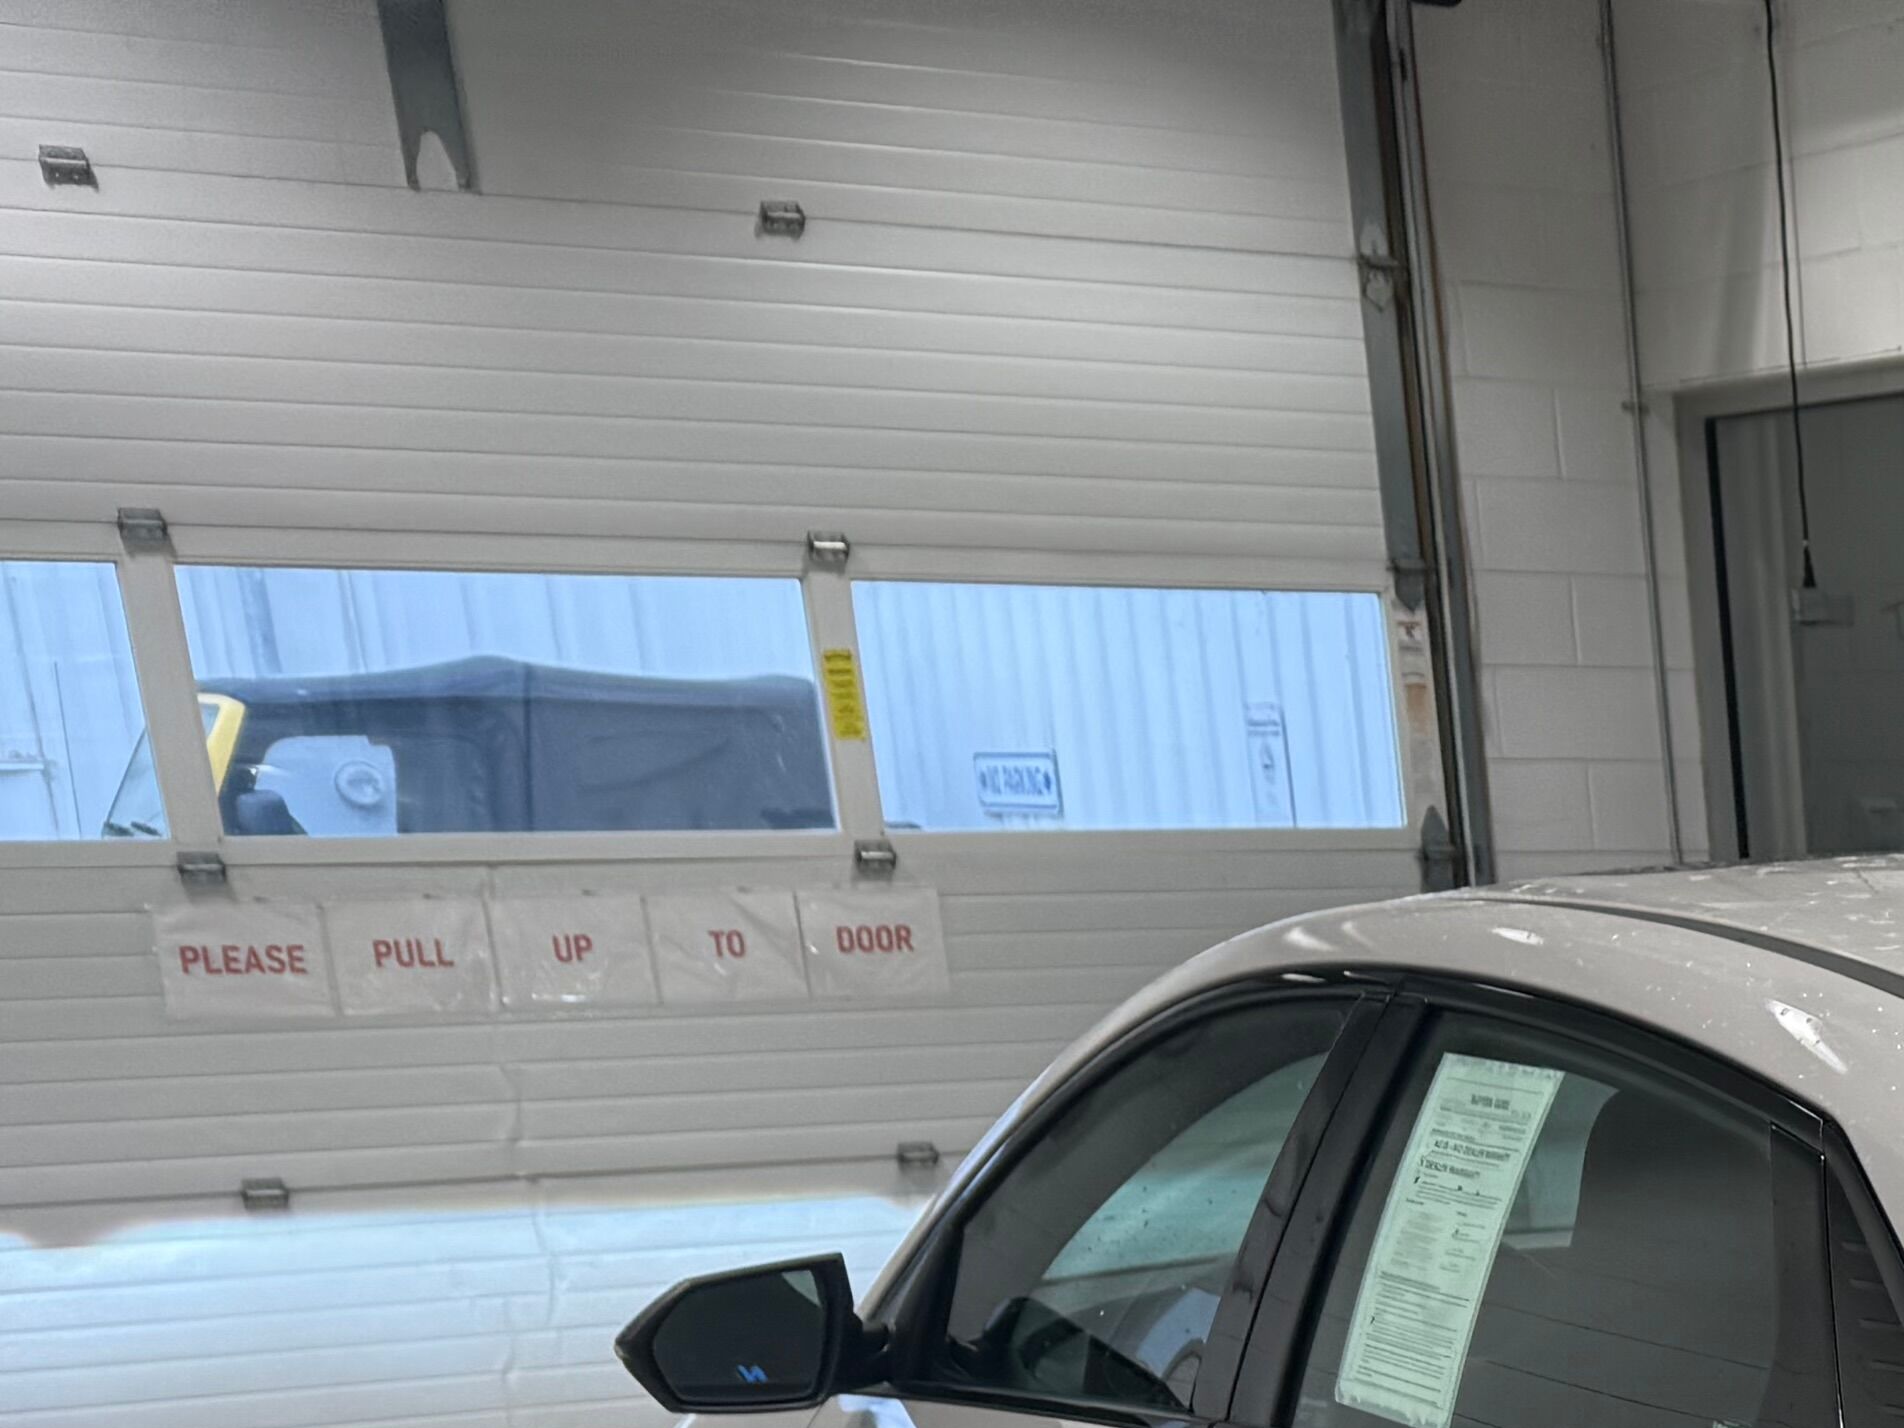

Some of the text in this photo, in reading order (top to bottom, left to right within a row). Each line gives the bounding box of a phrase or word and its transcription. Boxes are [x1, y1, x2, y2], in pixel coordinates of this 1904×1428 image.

[179, 924, 914, 975] PLEASE PULL UP TO DOOR
